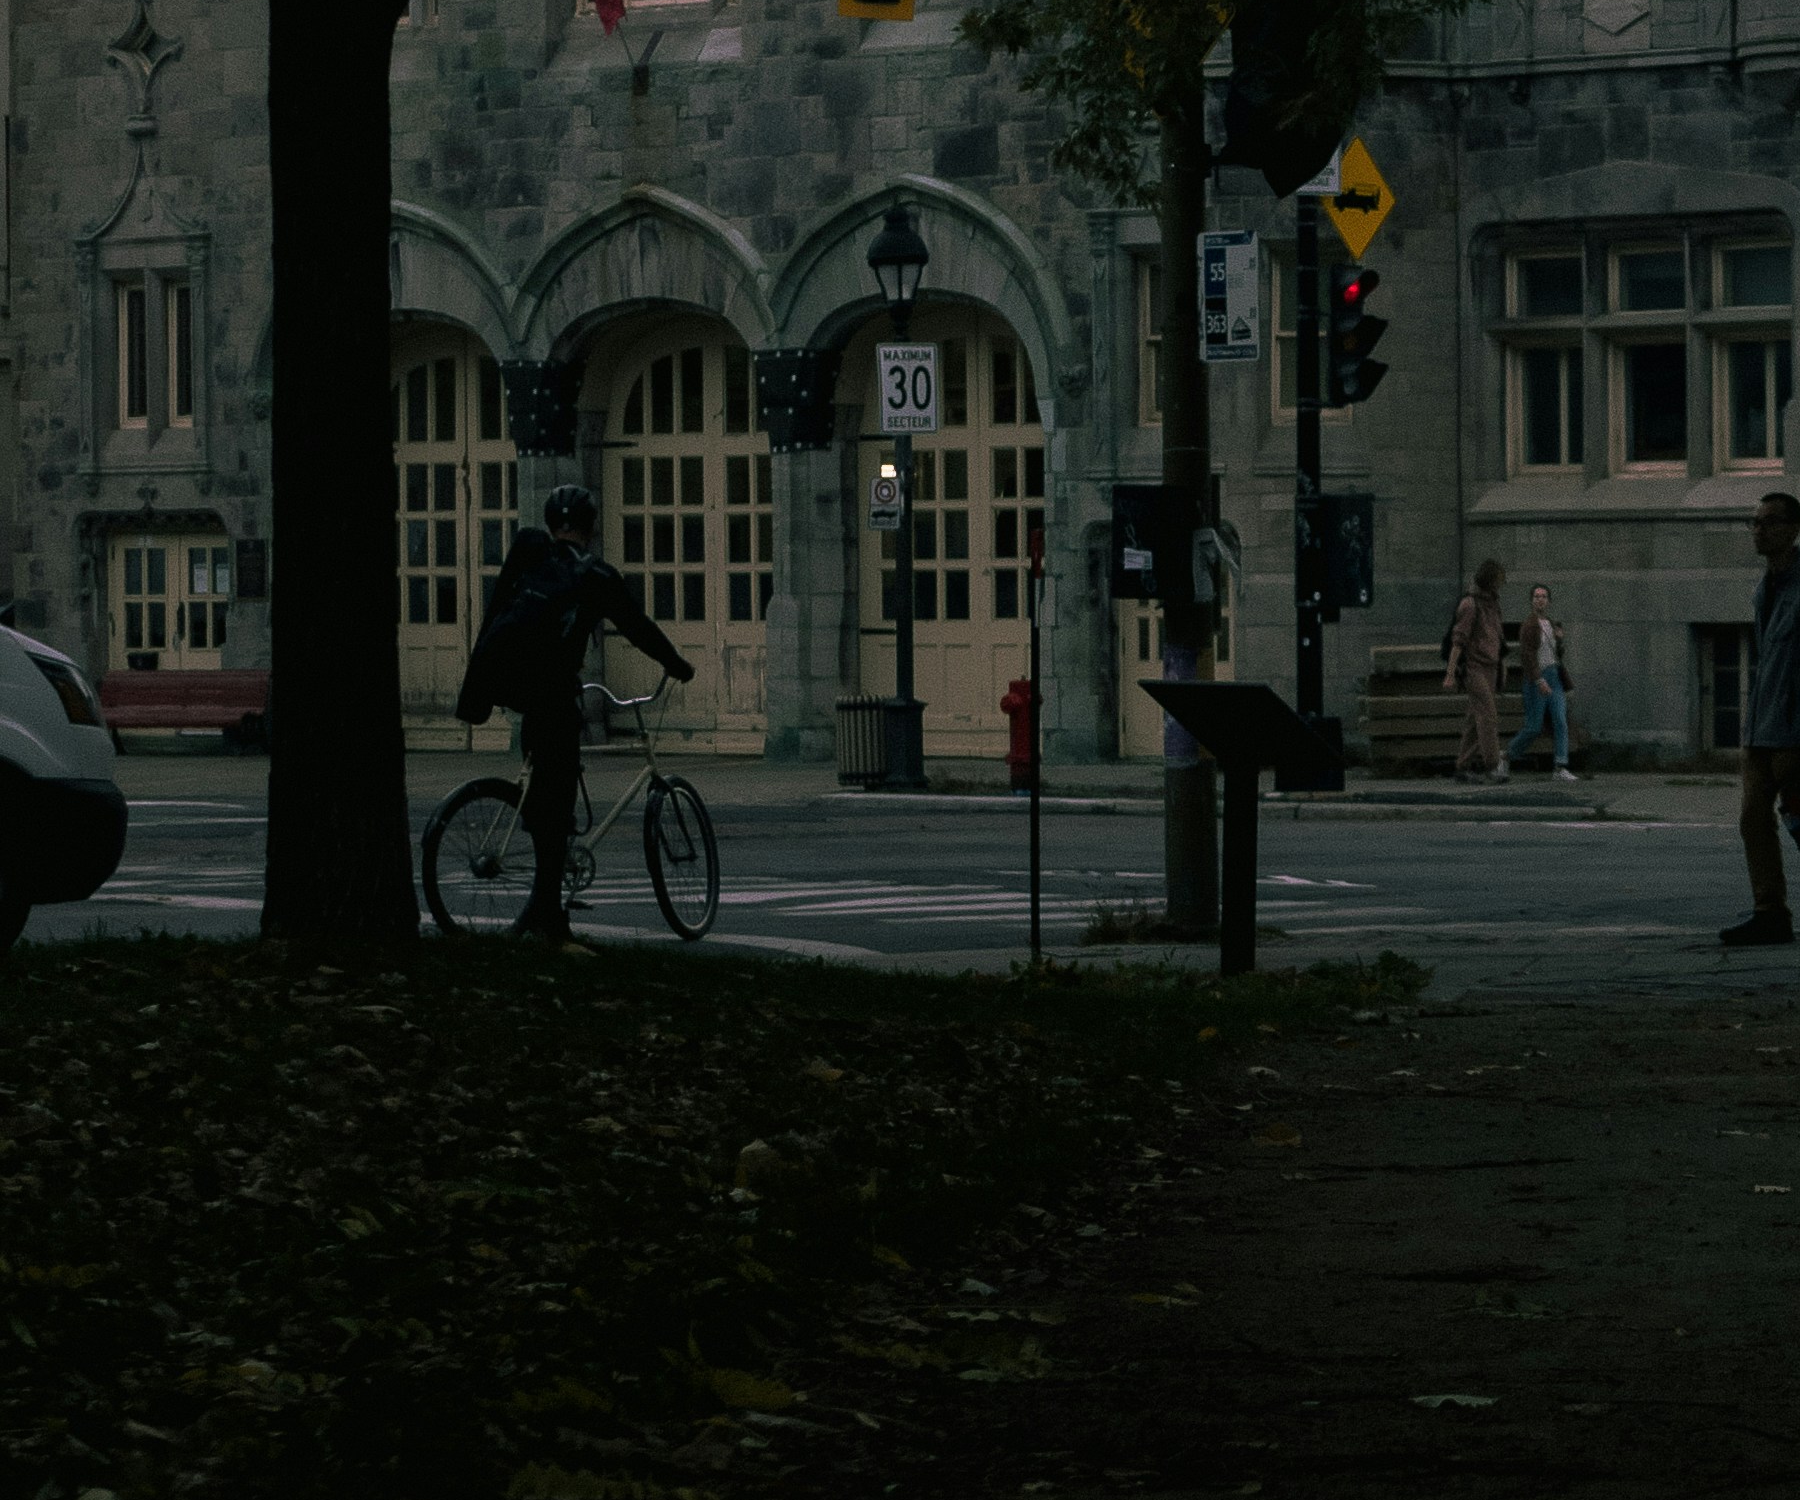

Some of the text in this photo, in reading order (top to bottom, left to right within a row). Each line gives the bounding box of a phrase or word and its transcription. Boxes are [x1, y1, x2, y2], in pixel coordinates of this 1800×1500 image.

[1210, 262, 1226, 282] 55
[1207, 314, 1227, 334] 363
[883, 350, 931, 361] MAXIMUM
[888, 365, 931, 410] 30
[887, 416, 931, 428] SECTEUR
